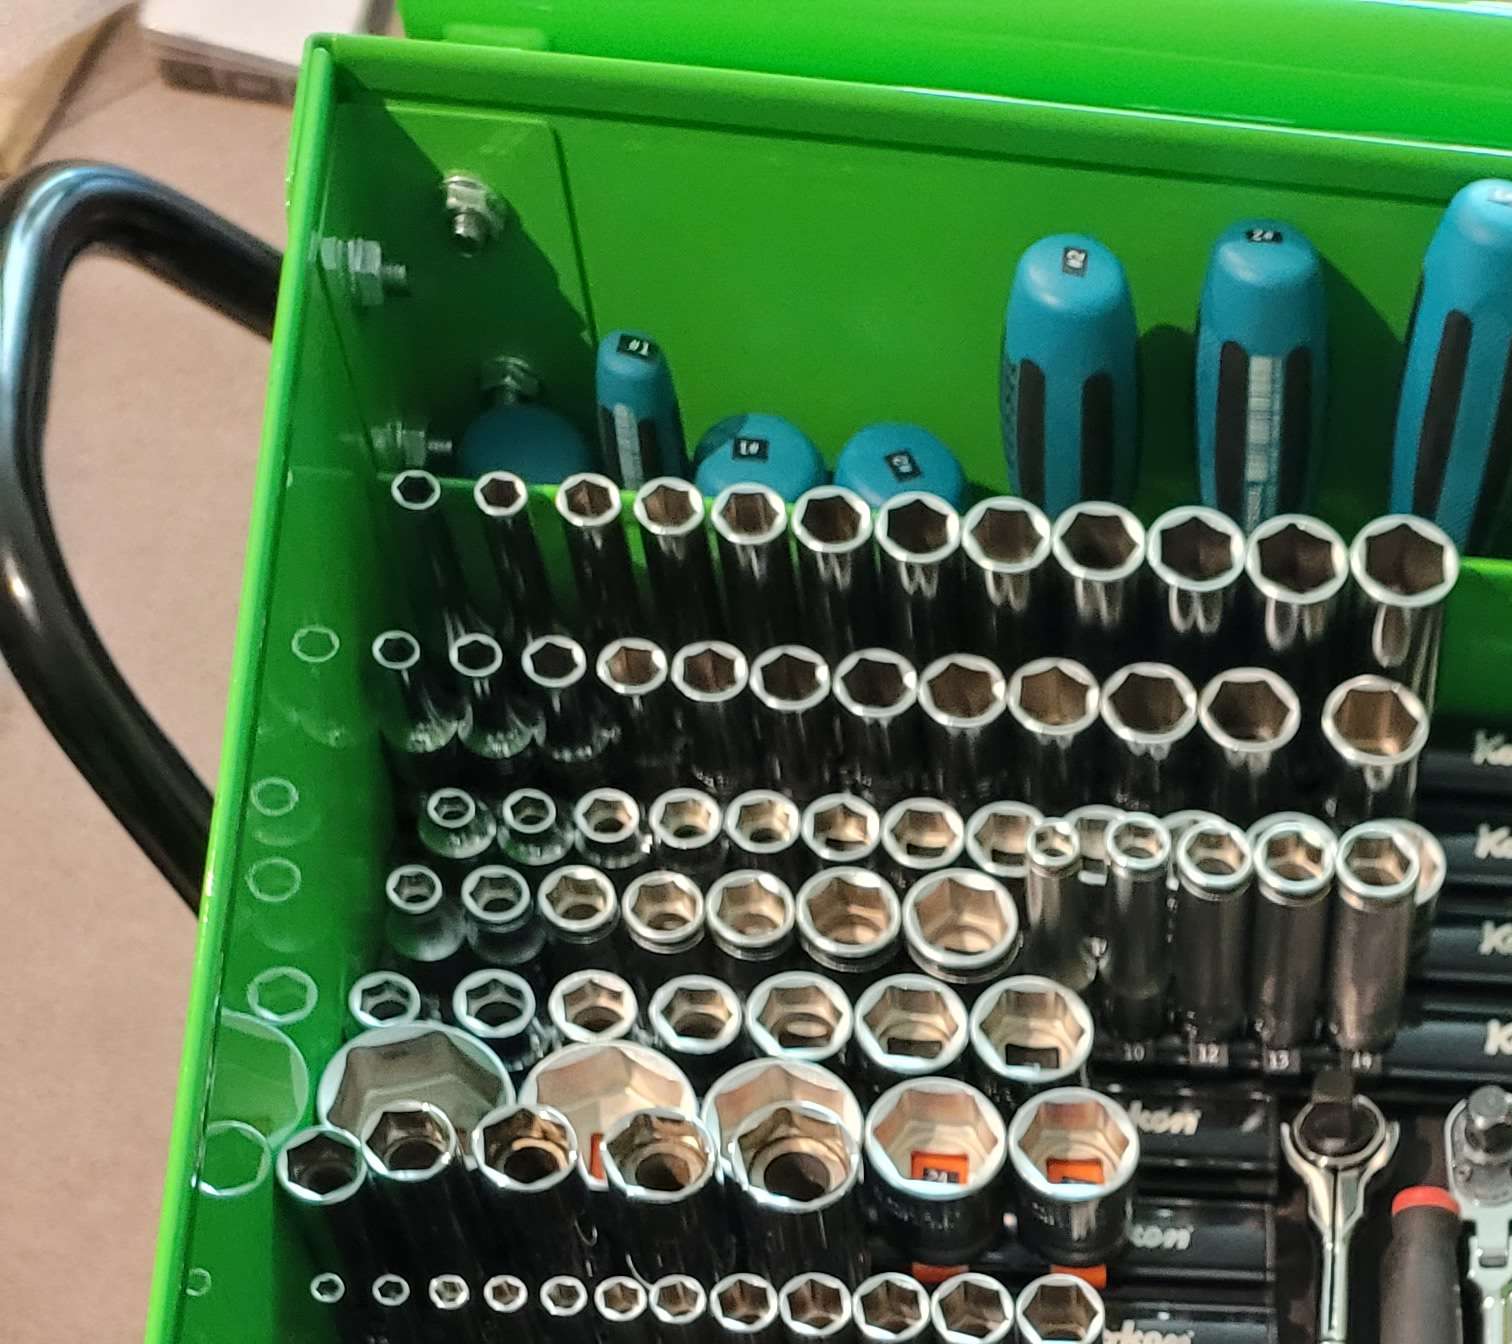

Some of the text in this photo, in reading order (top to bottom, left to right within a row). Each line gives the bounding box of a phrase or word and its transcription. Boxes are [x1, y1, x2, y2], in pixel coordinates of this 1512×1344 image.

[628, 339, 649, 356] #1
[1124, 1044, 1145, 1061] 10
[1199, 1043, 1220, 1063] 12
[1269, 1050, 1290, 1069] 13
[1352, 1052, 1373, 1069] 14
